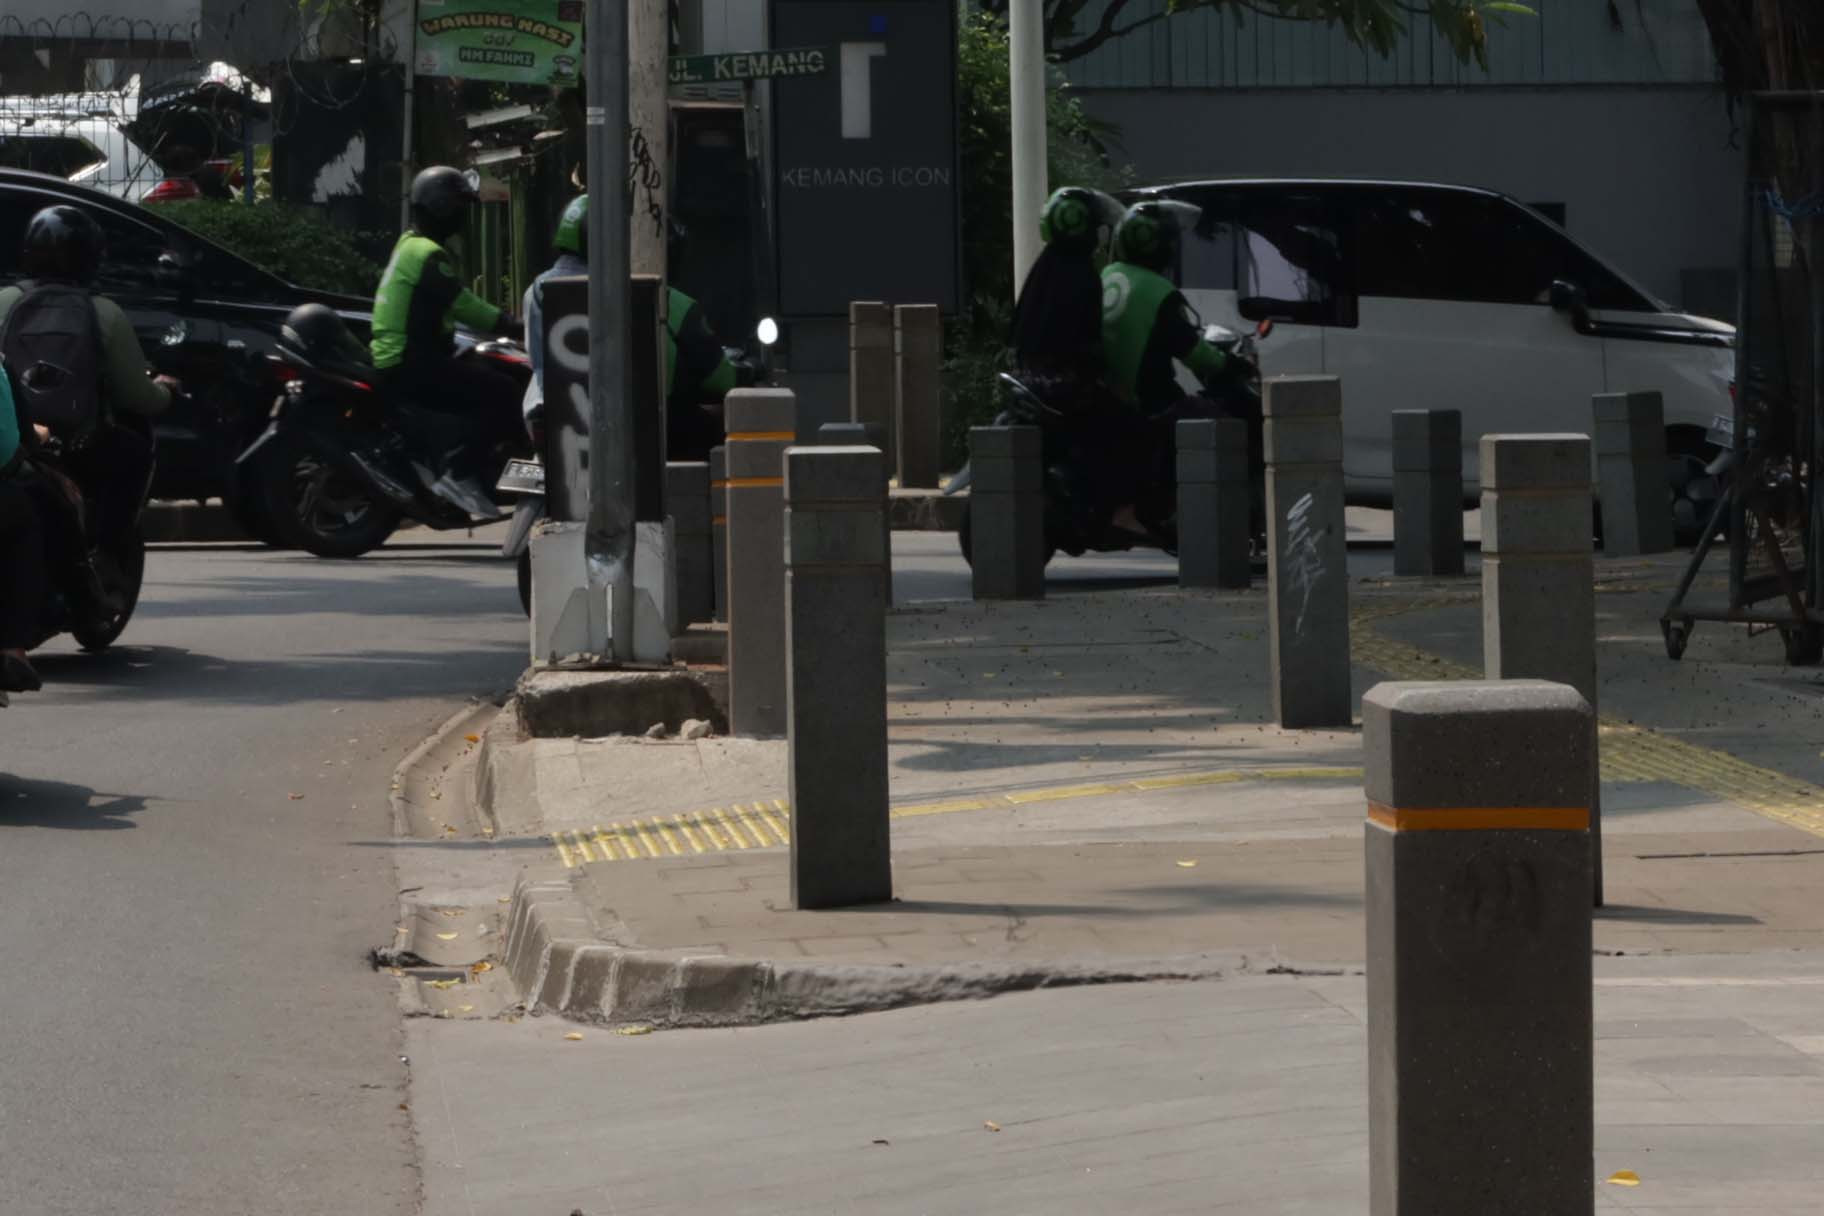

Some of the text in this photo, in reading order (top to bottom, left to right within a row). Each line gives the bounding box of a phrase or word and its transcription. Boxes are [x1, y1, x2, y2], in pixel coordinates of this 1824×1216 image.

[713, 50, 825, 80] KEMANG
[781, 167, 950, 187] KEMANG ICON
